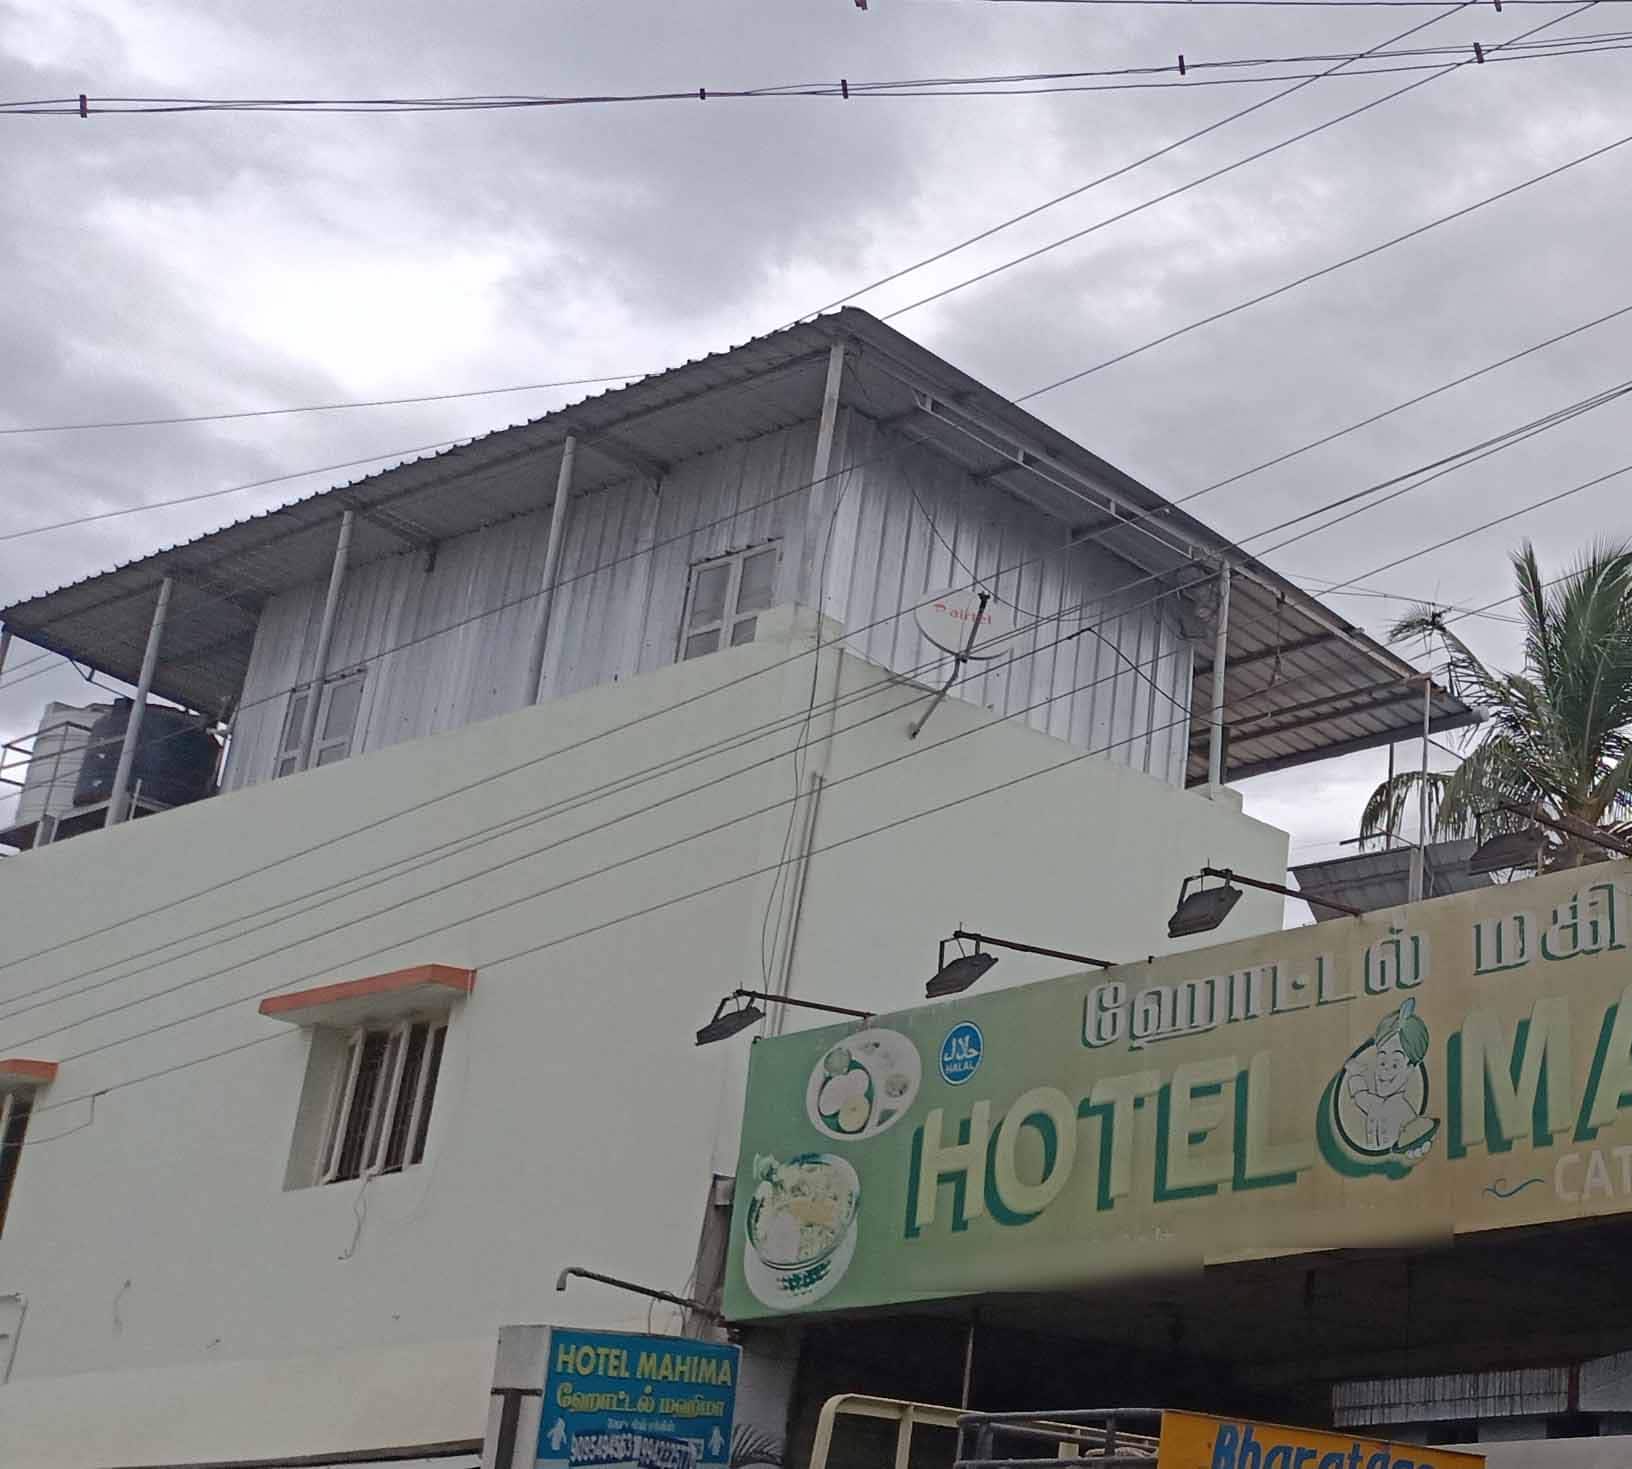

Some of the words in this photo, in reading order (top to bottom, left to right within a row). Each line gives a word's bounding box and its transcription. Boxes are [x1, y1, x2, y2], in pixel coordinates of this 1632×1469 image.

[904, 1049, 1313, 1239] HOTEL
[556, 1342, 630, 1378] HOTEL
[637, 1351, 733, 1386] MAHIMA
